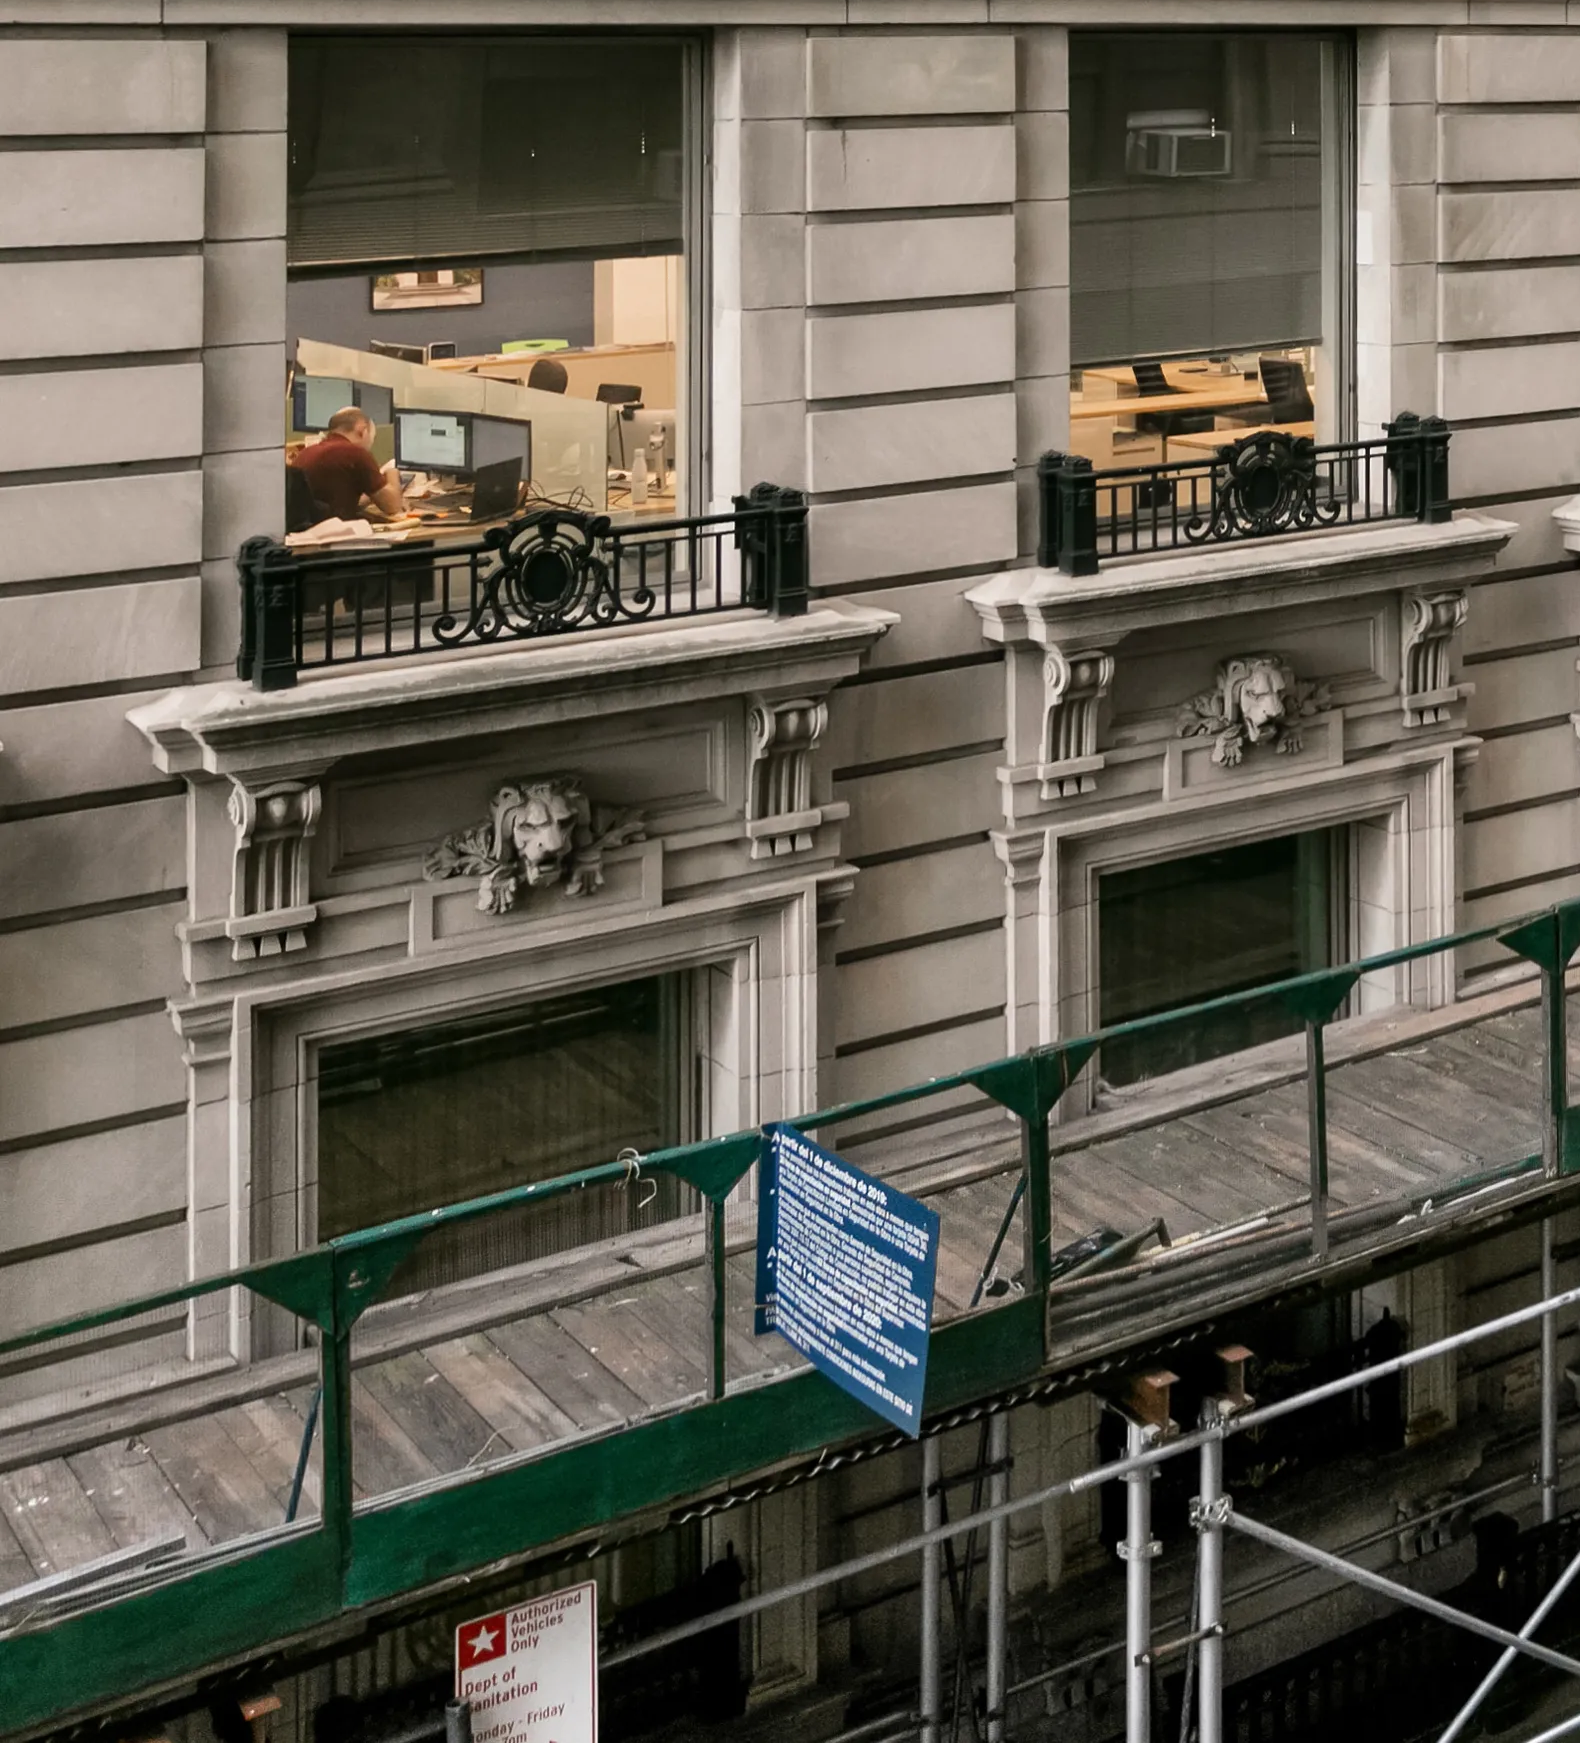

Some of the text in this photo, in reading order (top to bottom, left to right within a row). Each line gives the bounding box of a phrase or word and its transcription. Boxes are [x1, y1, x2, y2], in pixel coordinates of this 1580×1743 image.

[511, 1592, 582, 1625] Authorized
[511, 1613, 564, 1639] Vehicles
[511, 1634, 540, 1653] Only
[465, 1666, 516, 1696] Dept of
[472, 1721, 514, 1743] onday
[527, 1703, 565, 1726] Friday
